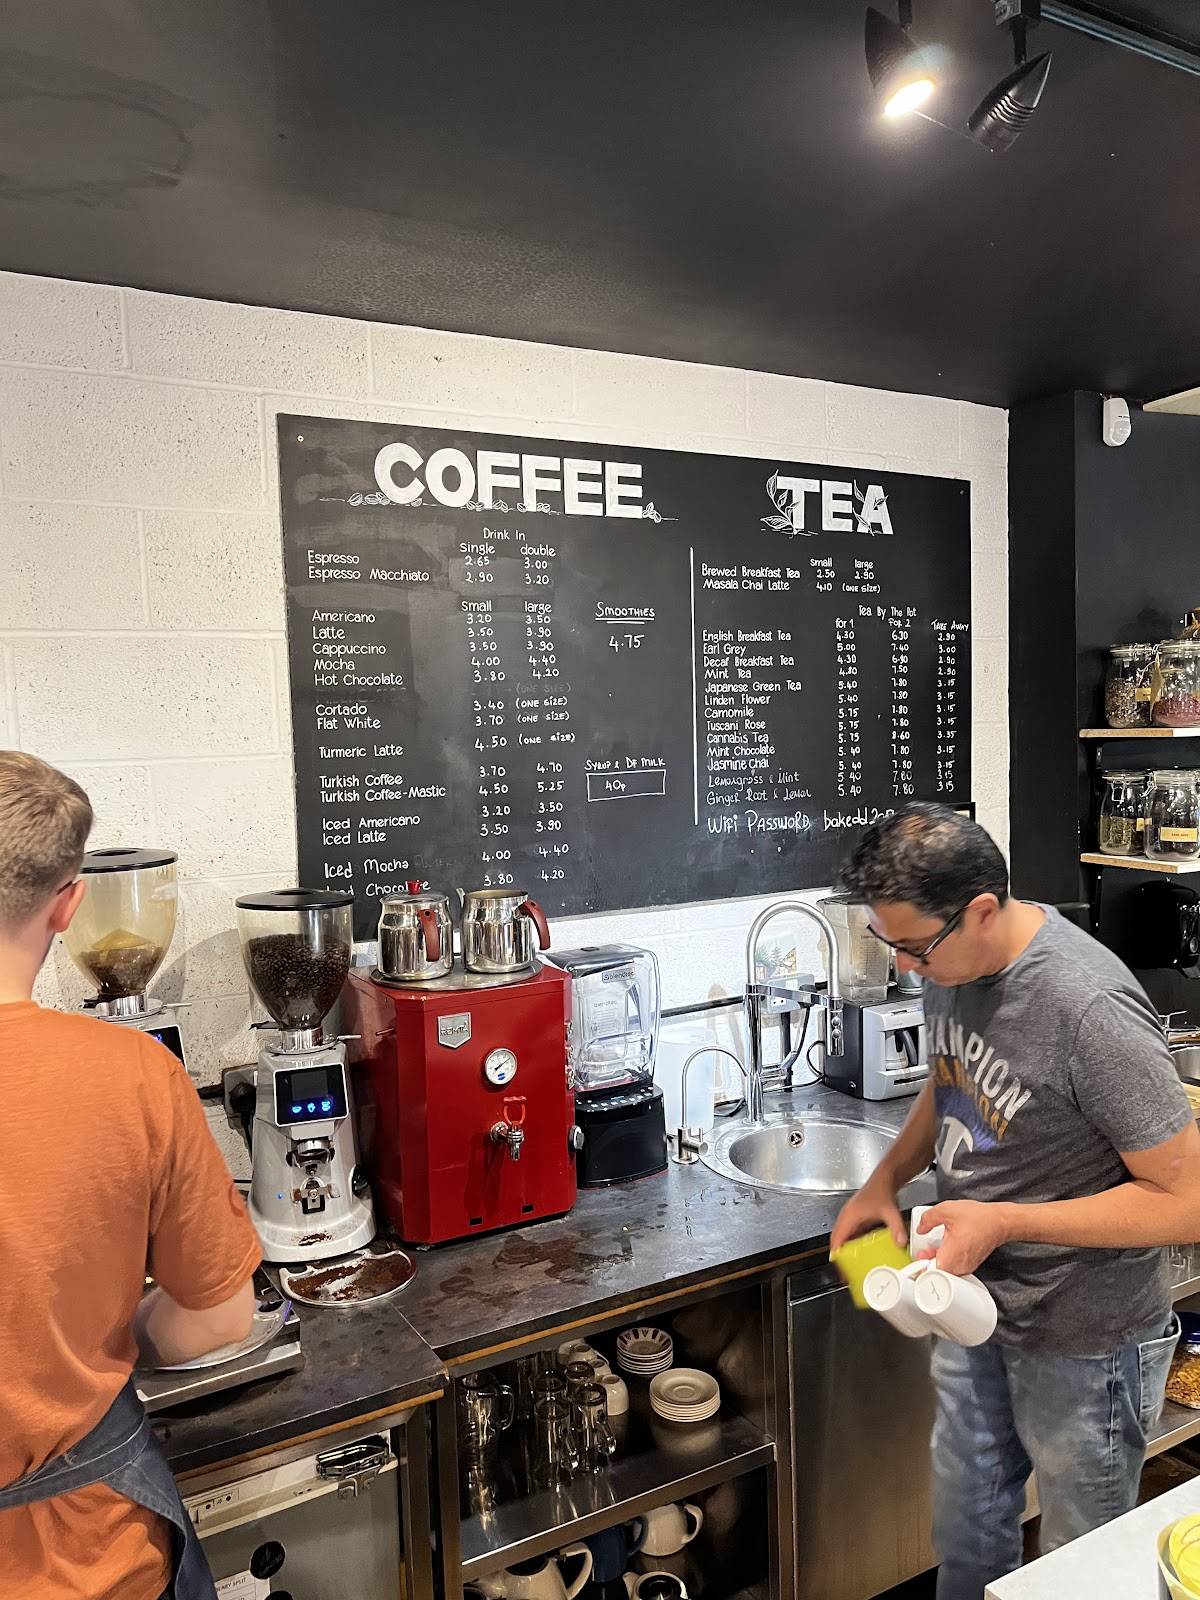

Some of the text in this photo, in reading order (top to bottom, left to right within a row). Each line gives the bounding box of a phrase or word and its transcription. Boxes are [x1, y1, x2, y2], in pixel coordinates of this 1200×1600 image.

[374, 442, 643, 519] COFFEE
[777, 476, 893, 534] TEA
[483, 527, 526, 541] Drink In
[520, 544, 556, 557] double
[308, 550, 360, 566] Espresso
[465, 555, 490, 567] 2.65
[524, 557, 548, 569] 3.00
[701, 563, 801, 579] Brewed Breakfast Tea
[854, 559, 874, 571] large
[308, 565, 431, 582] Espresso Macchiato
[465, 571, 494, 583] 2.90
[524, 573, 550, 585] 3.20
[816, 569, 835, 579] 2.50
[854, 570, 875, 580] 2.90
[703, 579, 790, 591] Masala Chai Latte
[525, 601, 552, 615] large
[859, 605, 917, 620] Tea By The Pot
[312, 609, 376, 623] Americano
[466, 613, 492, 624] 3.20
[525, 615, 551, 625] 3.50
[849, 619, 854, 628] 1
[904, 618, 911, 627] 2
[312, 626, 345, 640] Latte
[467, 626, 493, 638] 3.50
[526, 627, 552, 638] 3.90
[702, 630, 791, 643] English Breakfast Tea
[836, 631, 855, 641] 4.30
[937, 632, 956, 641] 2.90
[470, 641, 497, 652] 3.50
[527, 640, 555, 651] 3.90
[609, 634, 645, 652] 4.75
[836, 642, 856, 652] 5.00
[890, 643, 909, 652] 7.40
[938, 644, 956, 653] 3.00
[312, 642, 386, 657] Cappuccino
[703, 643, 746, 657] Earl Grey
[314, 658, 355, 671] Mocha
[471, 656, 500, 668] 4.00
[529, 654, 556, 667] 4.40
[703, 655, 795, 667] Decaf Breakfast Tea
[837, 654, 857, 664] 4.30
[532, 668, 560, 680] 4.20
[704, 668, 752, 680] Mint Tea
[891, 665, 909, 675] 7.50
[937, 667, 956, 675] 2.90
[315, 672, 404, 686] Hot Chocolate
[474, 670, 506, 683] 3.80
[705, 680, 802, 696] Japanese Green Tea
[937, 679, 956, 687] 3.15
[704, 694, 771, 706] Linden Flower
[838, 694, 858, 704] 5.40
[892, 690, 909, 700] 7.80
[937, 691, 956, 700] 3.15
[316, 703, 367, 716] Cortado
[473, 700, 504, 712] 3.40
[704, 706, 754, 718] Camomile
[936, 703, 956, 713] 3.15
[838, 708, 860, 719] 5.75
[317, 716, 381, 730] Flat White
[475, 715, 504, 727] 3.70
[706, 719, 766, 731] Tuscani Rose
[936, 716, 957, 726] 3.15
[706, 731, 769, 744] Cannabis Tea
[892, 731, 910, 740] 8.60
[937, 730, 957, 739] 3.35
[474, 735, 507, 752] 4.50
[891, 744, 910, 755] 7.80
[936, 745, 956, 754] 3.15
[319, 744, 403, 759] Turmeric Latte
[706, 743, 776, 757] Mint Chocolate
[536, 761, 563, 774] 4.70
[707, 755, 769, 771] Jasmine Chai
[892, 759, 912, 769] 7.80
[937, 760, 955, 769] 3.15
[480, 765, 506, 778] 3.70
[892, 770, 912, 782] 7.80
[320, 773, 403, 789] Turkish Coffee
[537, 781, 564, 793] 5.25
[605, 780, 626, 792] 40p
[320, 785, 446, 803] Turkish Coffee-Mastic
[479, 783, 508, 797] 4.50
[892, 783, 914, 797] 7.80
[482, 805, 511, 818] 3.20
[538, 802, 563, 814] 3.50
[323, 815, 421, 831] Iced Americano
[535, 820, 562, 833] 3.90
[480, 823, 509, 837] 3.50
[323, 830, 387, 846] Iced Latte
[481, 850, 511, 863] 4.00
[539, 843, 569, 858] 4.40
[324, 862, 353, 879] Iced
[364, 858, 409, 874] Mocha
[483, 873, 514, 887] 3.80
[541, 870, 565, 882] 4.20
